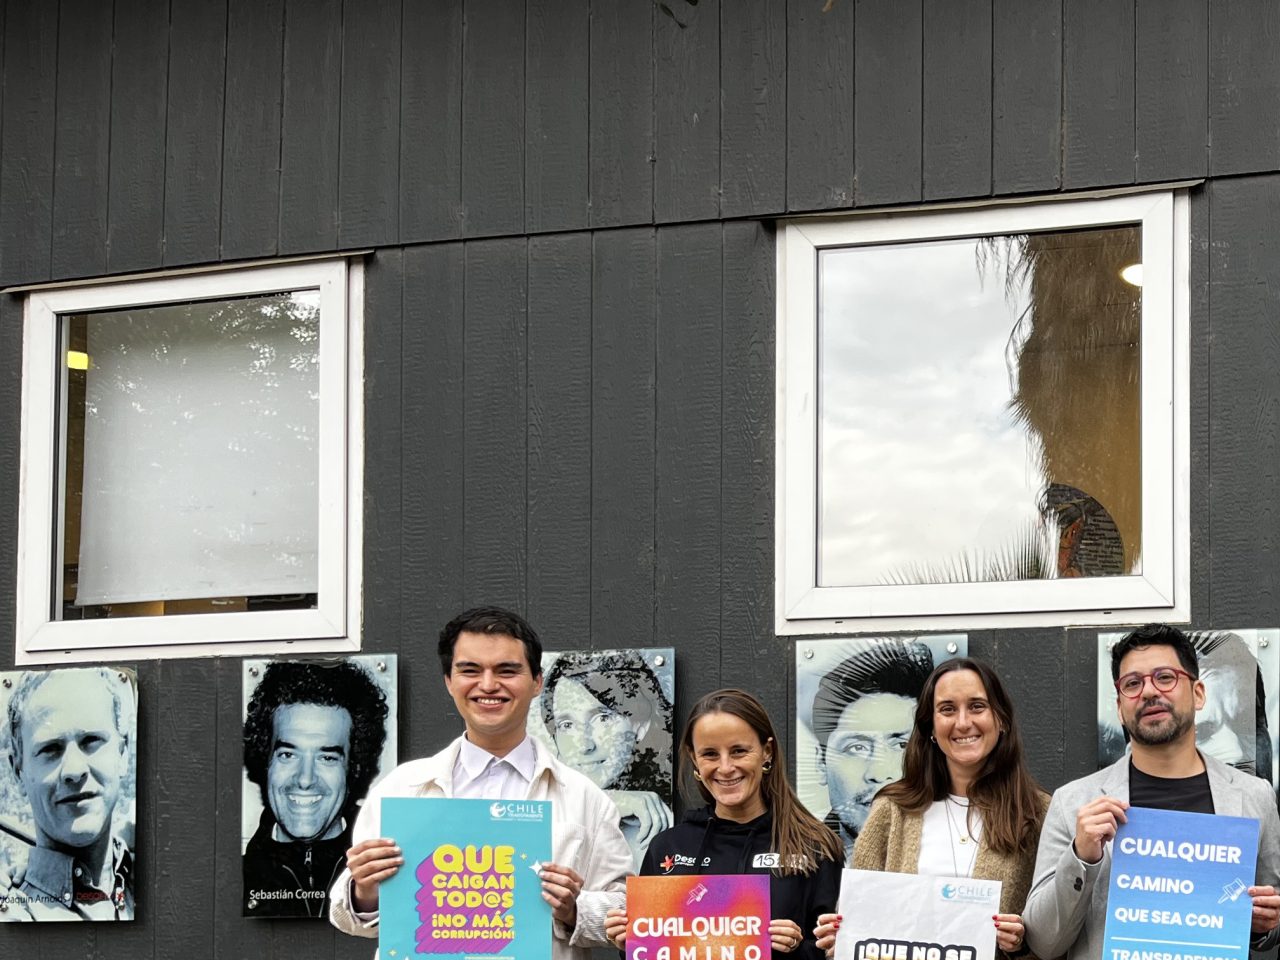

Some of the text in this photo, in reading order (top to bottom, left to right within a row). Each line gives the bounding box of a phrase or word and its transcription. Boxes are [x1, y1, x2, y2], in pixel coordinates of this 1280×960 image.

[507, 803, 544, 814] CHILE
[432, 843, 515, 874] QUE
[1120, 837, 1242, 864] CUALQUIER
[756, 854, 775, 867] 15
[431, 873, 515, 890] CAIGAN
[1116, 874, 1194, 895] CAMINO
[249, 889, 326, 900] Sebastián Correa
[958, 885, 993, 897] CHILE
[472, 910, 515, 928] MÁS
[1114, 907, 1224, 929] QUE SEA CON
[431, 928, 515, 939] CORRUPCIÓN!
[632, 916, 762, 941] CUALQUIER
